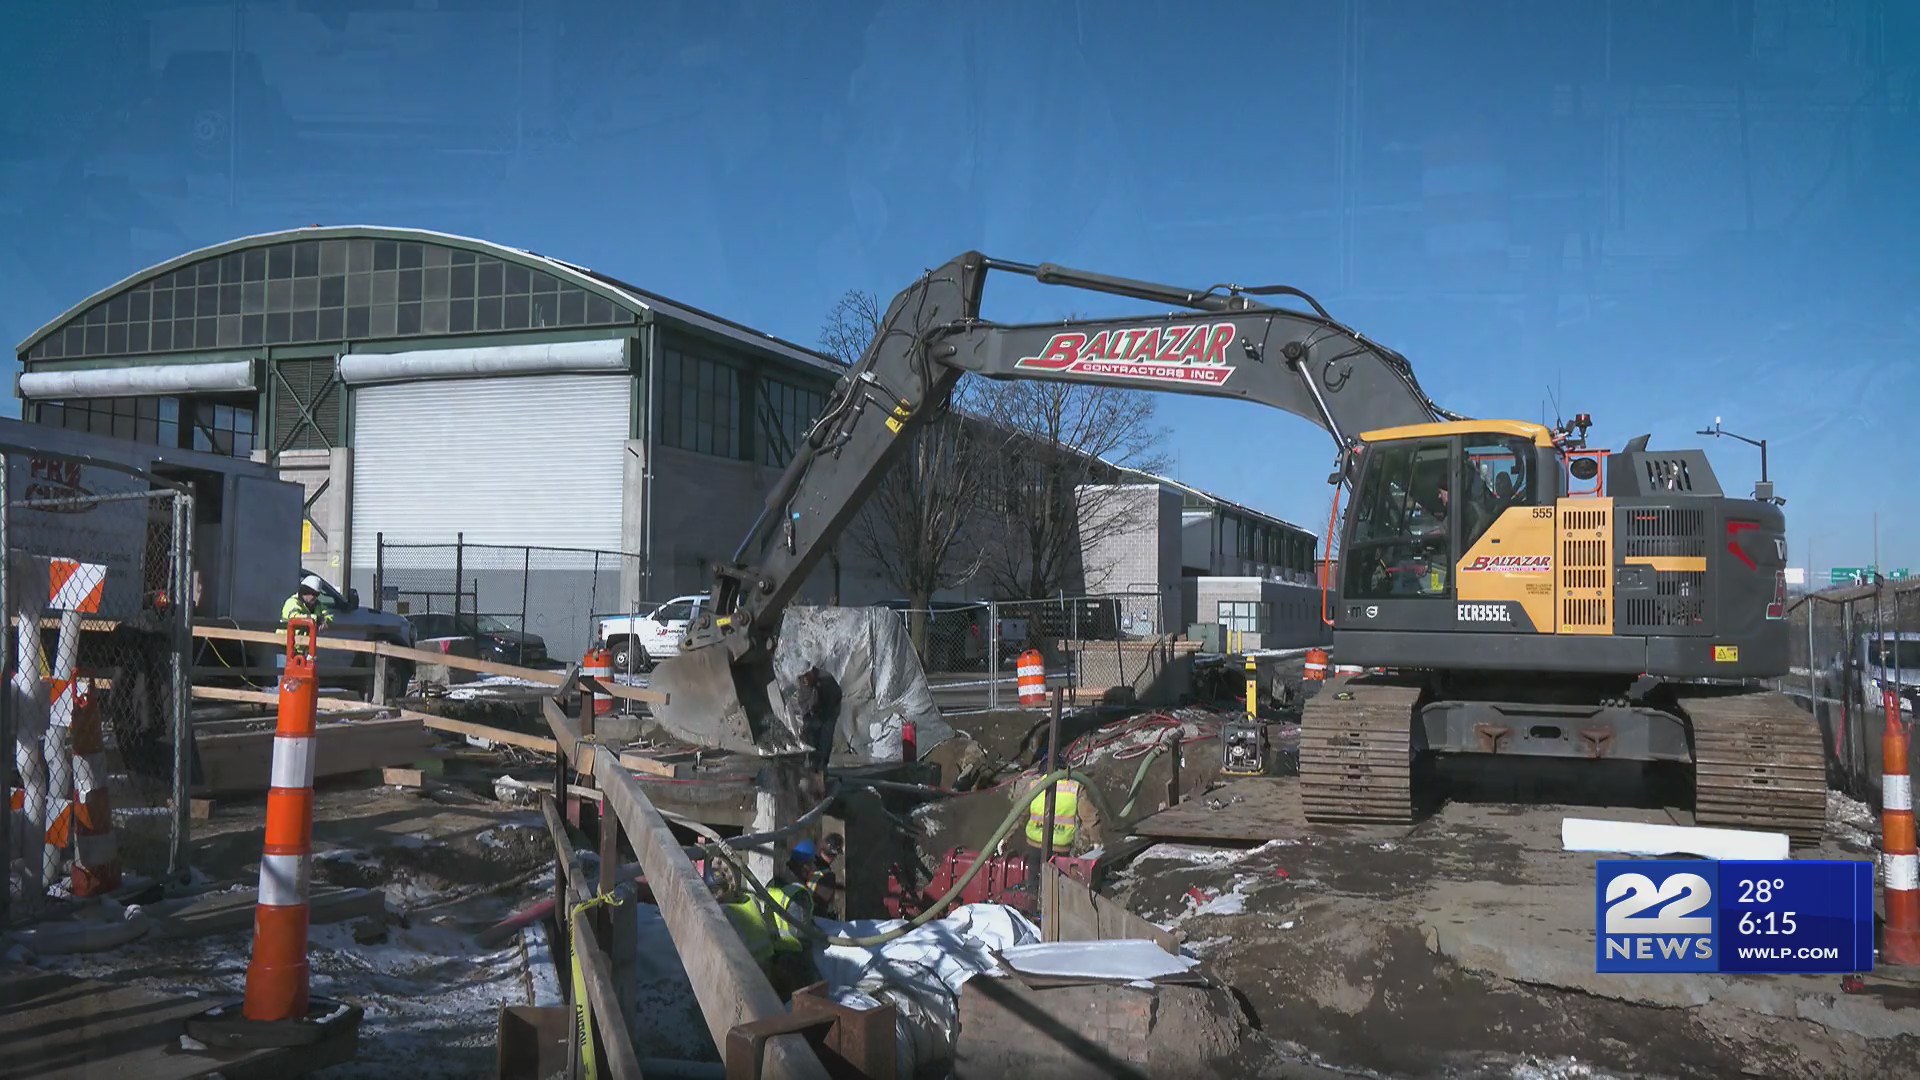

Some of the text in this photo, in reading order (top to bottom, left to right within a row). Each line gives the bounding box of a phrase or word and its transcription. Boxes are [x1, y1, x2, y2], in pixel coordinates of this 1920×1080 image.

[1015, 322, 1236, 372] BALTAZAR
[1082, 363, 1219, 381] CONTRACTORS INC.
[1532, 508, 1553, 519] 555
[331, 555, 340, 567] 2
[1462, 555, 1552, 572] BALTAZAR
